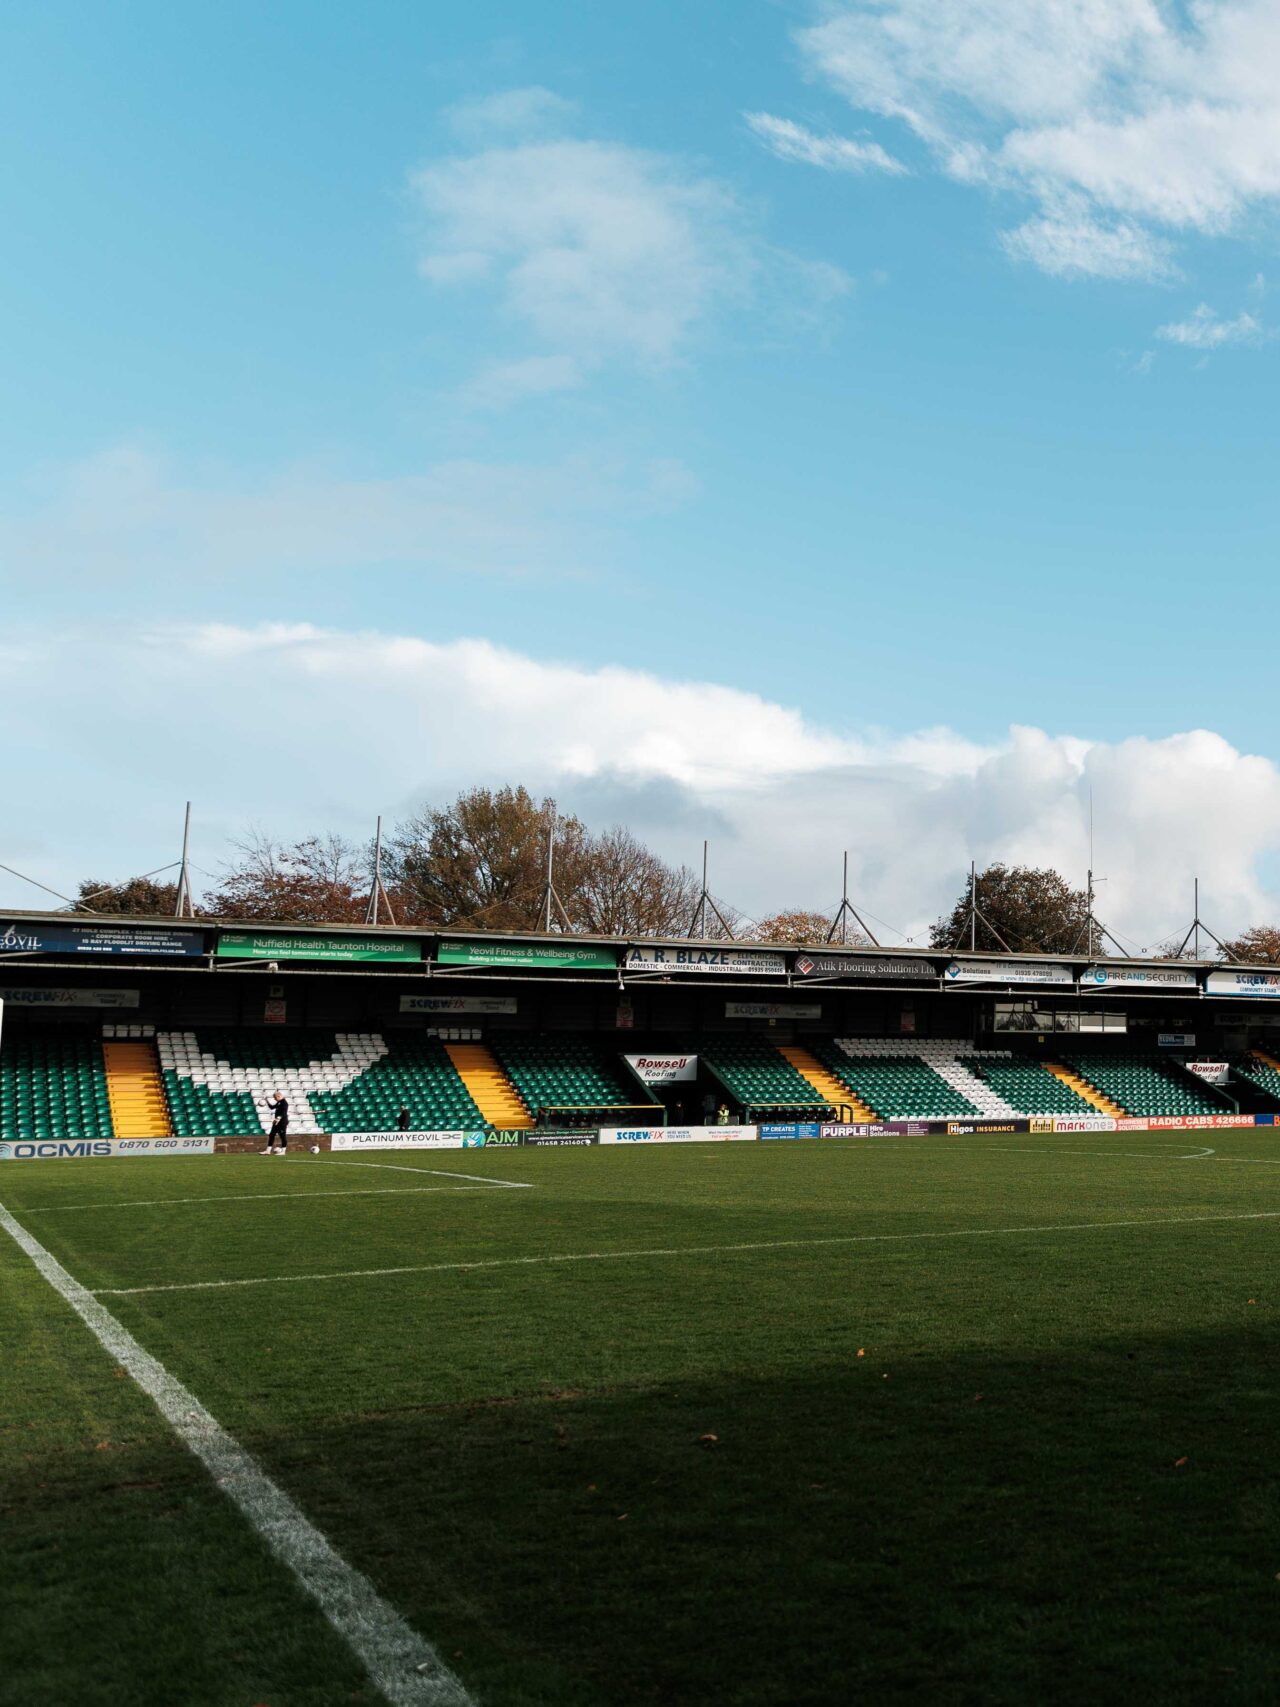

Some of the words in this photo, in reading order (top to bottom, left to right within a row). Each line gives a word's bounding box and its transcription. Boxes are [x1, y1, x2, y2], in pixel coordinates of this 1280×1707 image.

[253, 938, 292, 950] Nuffield
[293, 940, 325, 951] Health
[327, 941, 365, 951] Taunton
[366, 942, 404, 954] Hospital
[338, 951, 353, 960] today
[469, 946, 495, 956] Yeovil
[496, 947, 526, 957] Fitness
[527, 948, 534, 957] &
[535, 949, 575, 962] Wellbeing
[576, 950, 597, 962] Gym
[630, 949, 648, 963] A.
[655, 950, 670, 963] R.
[676, 950, 729, 966] BLAZE
[737, 953, 777, 961] ELECTRICAL
[468, 956, 490, 964] Building
[732, 960, 783, 968] CONTRACTORS
[629, 962, 658, 970] DOMESTIC
[663, 964, 702, 972] COMMERCIAL
[708, 965, 742, 973] INDUSTRIAL
[838, 962, 876, 975] Flooring
[877, 963, 919, 974] Solutions
[921, 965, 935, 974] Ltd
[962, 967, 991, 976] Solutions
[1235, 974, 1280, 987] SCREWFIX
[637, 1058, 687, 1069] Rowsell
[1191, 1064, 1225, 1073] Rowsell
[645, 1069, 677, 1079] Roofing
[1149, 1117, 1183, 1126] RADIO
[1185, 1116, 1214, 1126] CABS
[1216, 1115, 1255, 1125] 426666
[822, 1126, 867, 1137] PURPLE
[950, 1123, 974, 1135] Higos
[976, 1125, 1016, 1133] INSURANCE
[352, 1134, 405, 1143] PLATINUM
[406, 1133, 440, 1142] YEOVIL
[486, 1130, 519, 1143] AJM
[616, 1130, 665, 1142] SCREWFIX
[14, 1141, 112, 1158] OCMIS
[119, 1140, 150, 1149] 0870
[154, 1139, 177, 1148] 600
[182, 1139, 209, 1148] 5131
